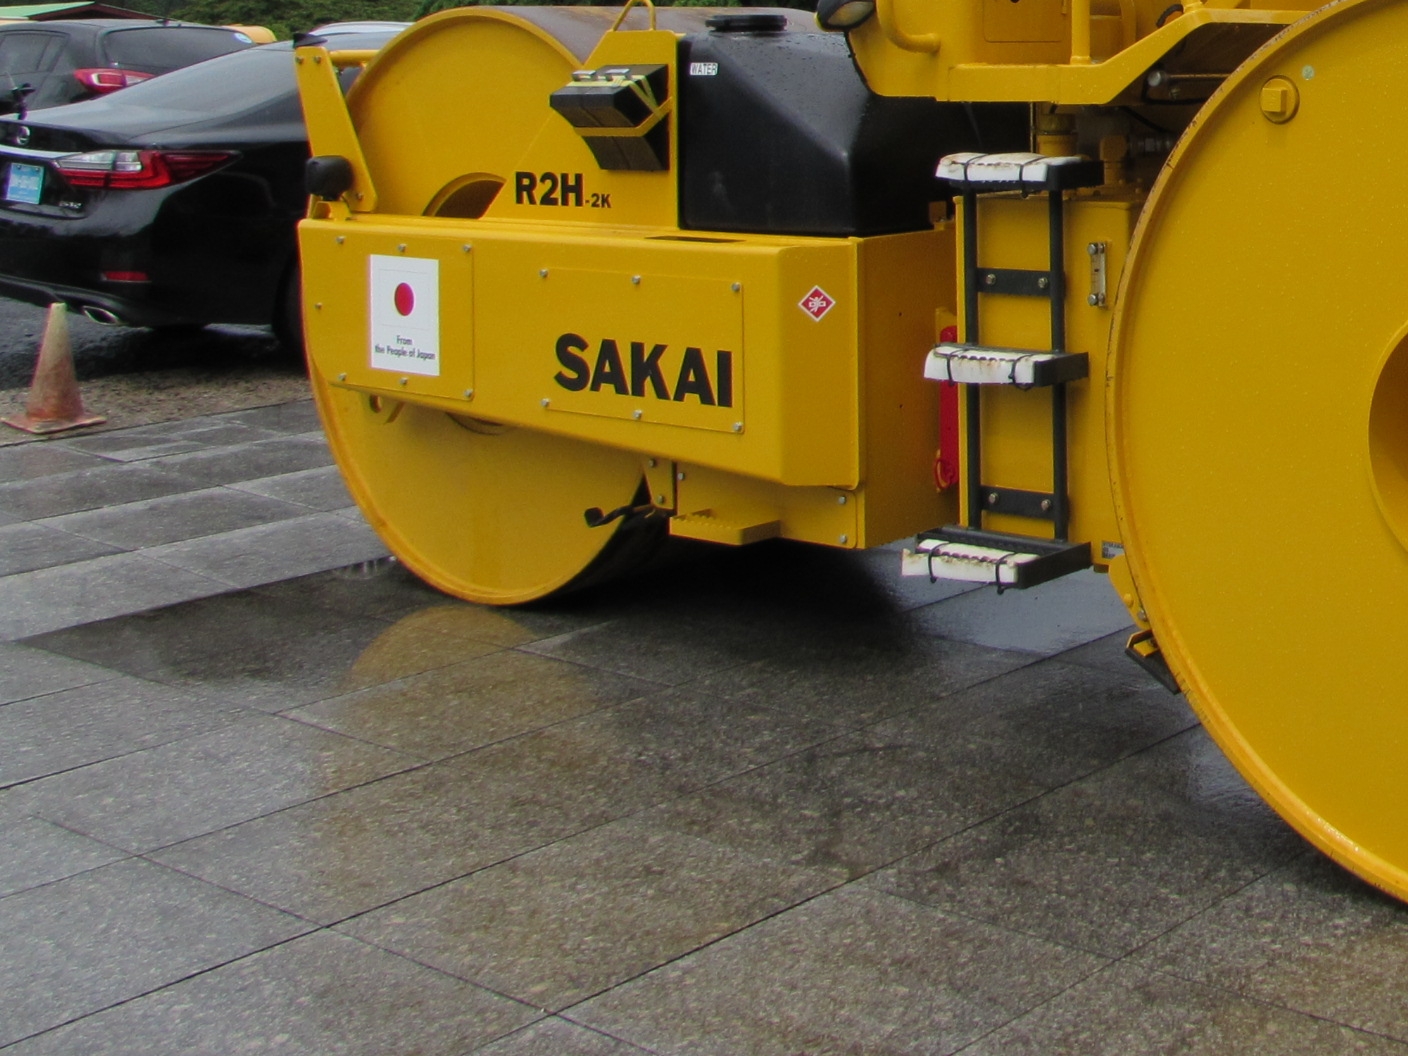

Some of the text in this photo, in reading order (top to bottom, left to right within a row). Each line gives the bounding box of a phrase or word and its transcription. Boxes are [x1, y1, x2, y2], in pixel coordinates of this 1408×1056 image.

[691, 62, 718, 75] WATER
[396, 335, 413, 346] From
[375, 344, 436, 361] the People of Japan
[553, 332, 733, 408] SAKAI
